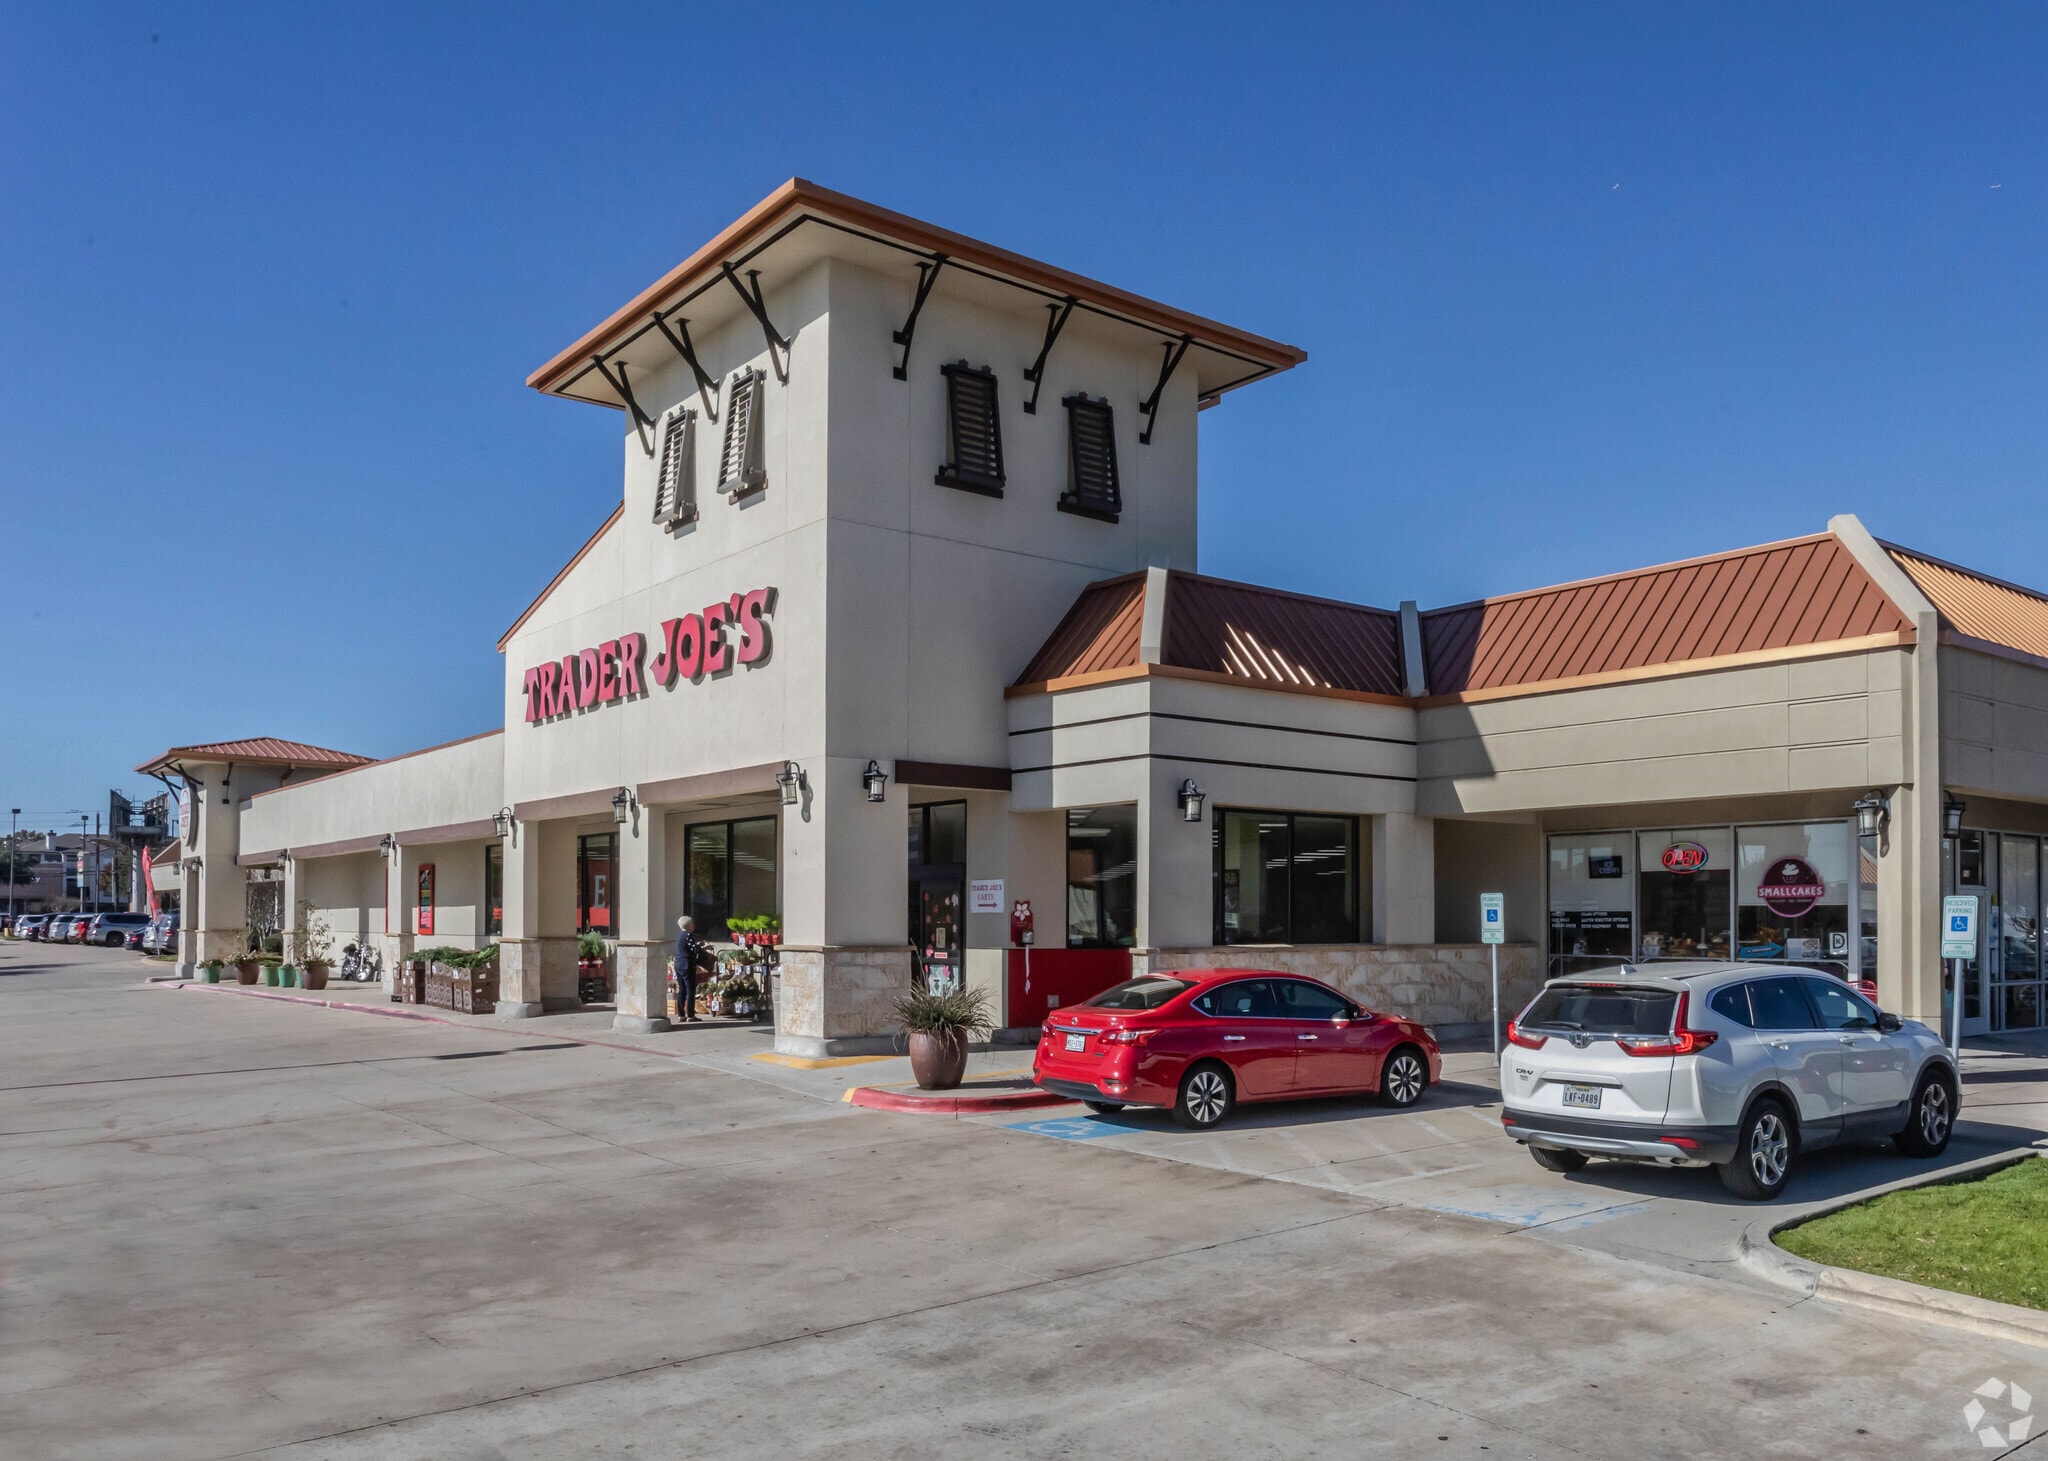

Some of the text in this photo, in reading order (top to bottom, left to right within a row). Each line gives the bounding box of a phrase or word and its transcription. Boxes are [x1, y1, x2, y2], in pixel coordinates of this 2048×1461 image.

[522, 586, 778, 726] TRADER JOE'S
[1663, 849, 1703, 867] OPEN
[971, 884, 989, 892] TRADER
[1758, 886, 1823, 897] SMALLCAKES
[977, 893, 995, 901] CARTS
